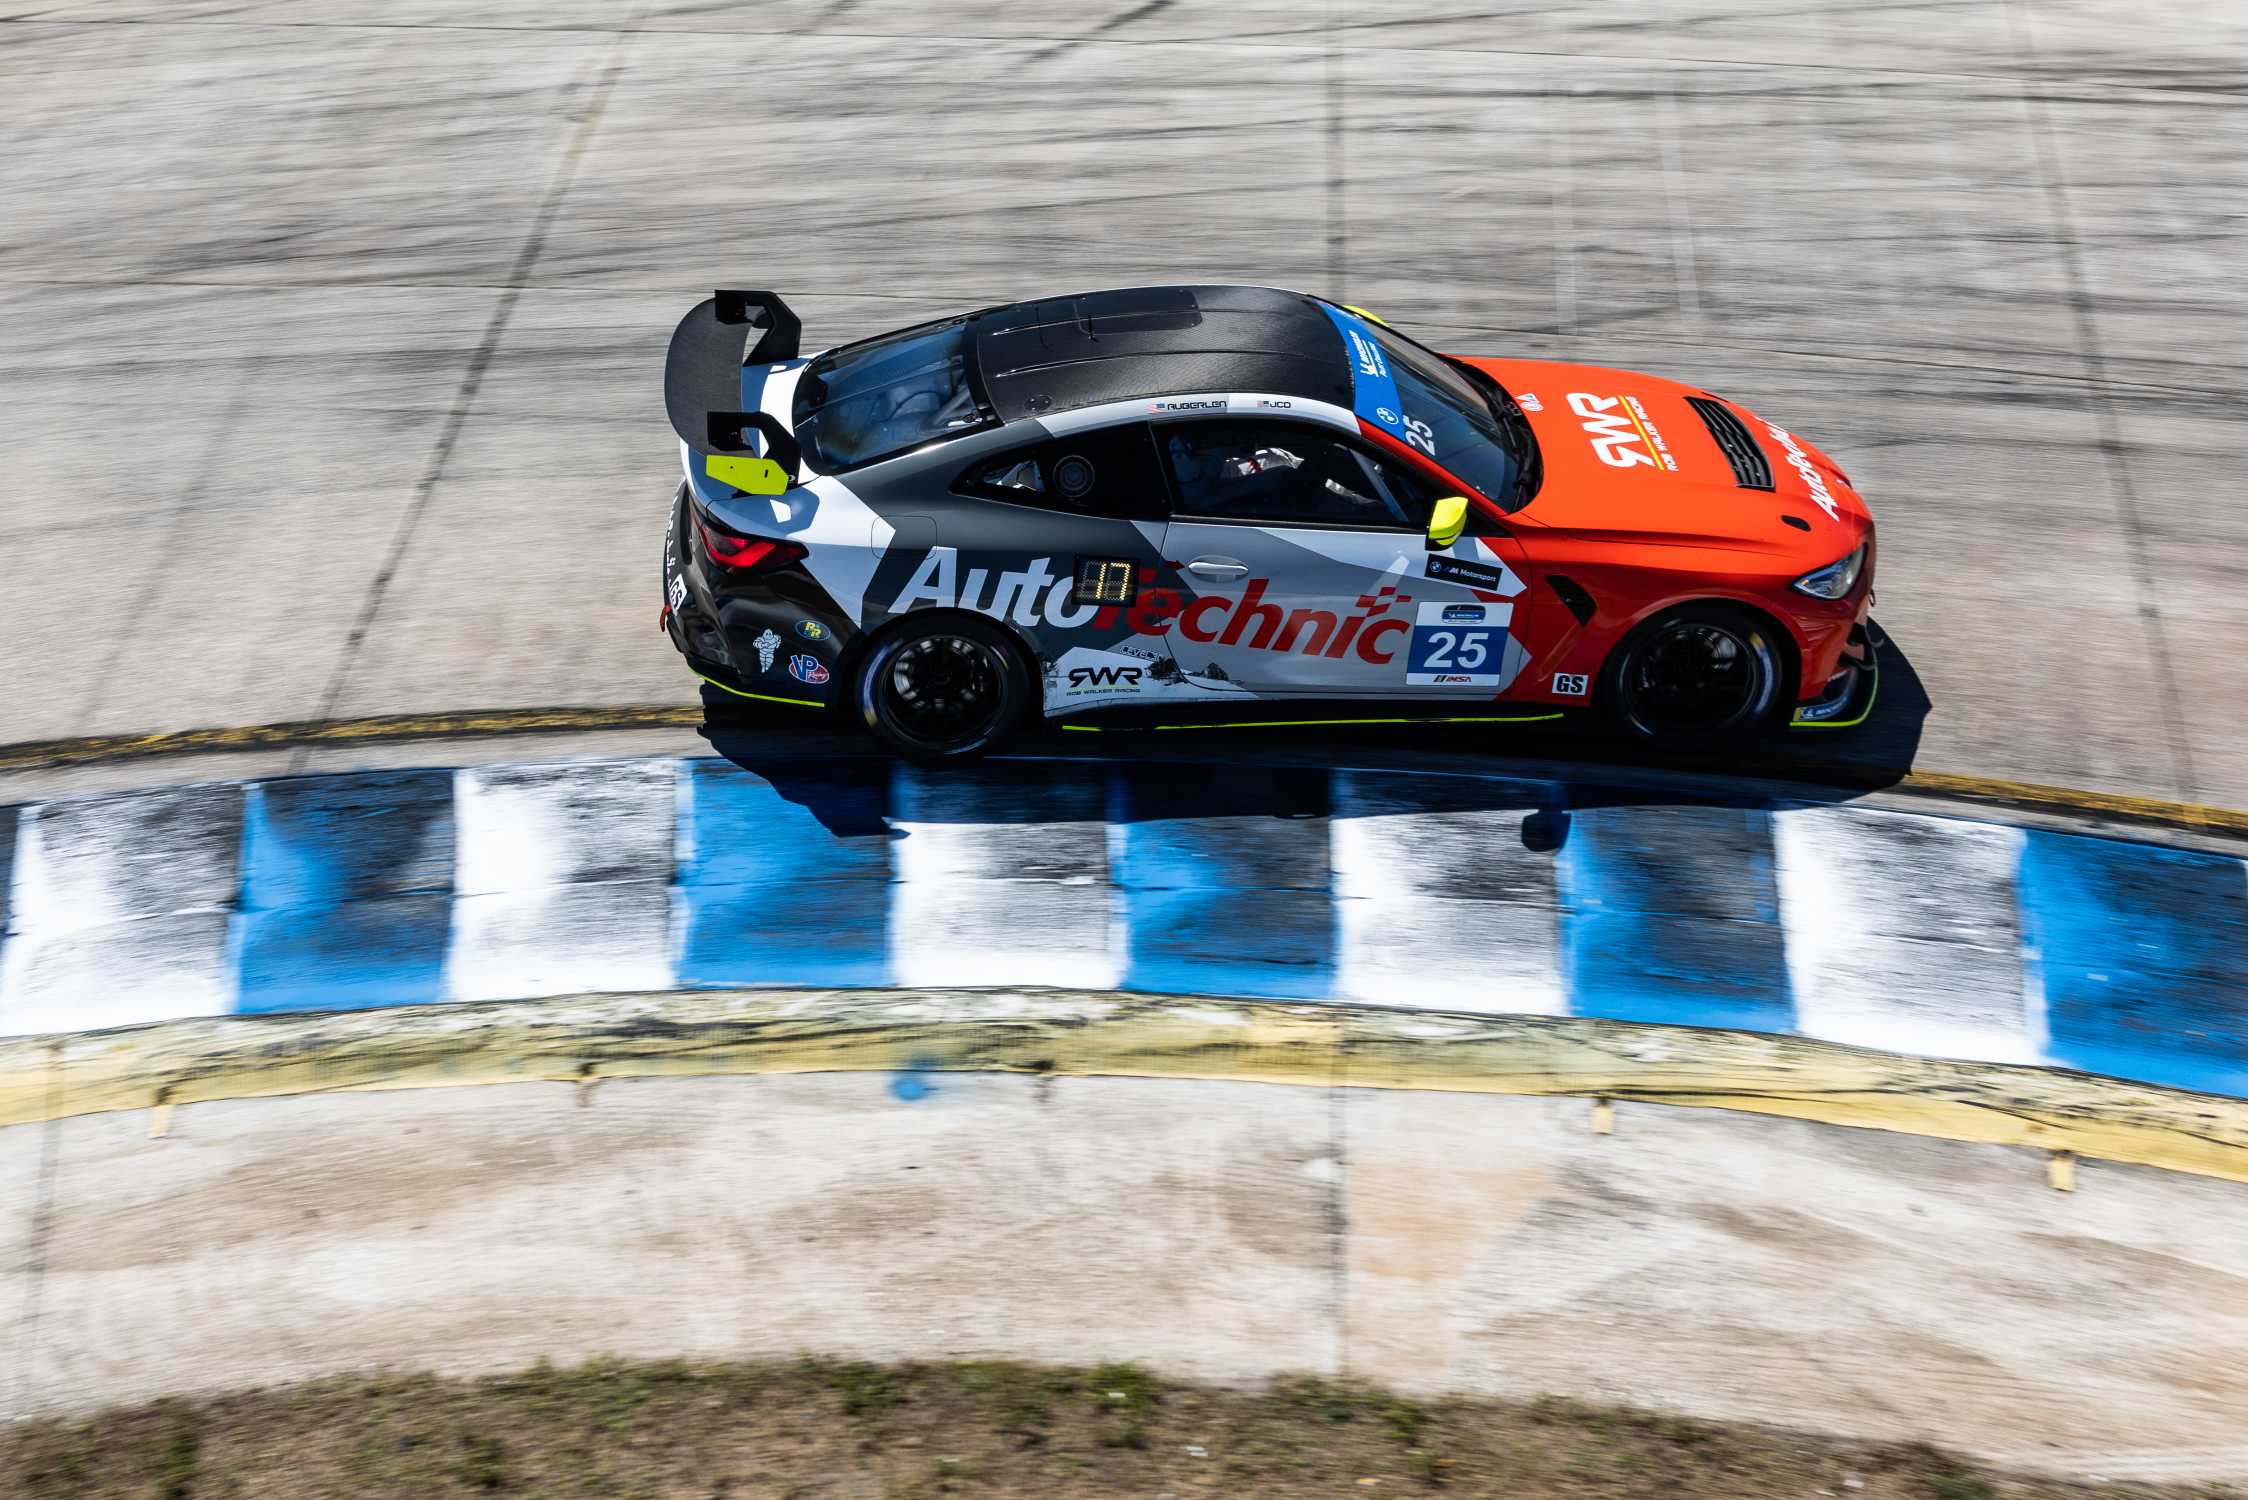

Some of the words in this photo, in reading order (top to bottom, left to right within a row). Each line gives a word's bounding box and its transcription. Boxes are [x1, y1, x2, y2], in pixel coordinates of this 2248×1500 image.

[1167, 400, 1228, 411] AUBERLEN
[1403, 415, 1436, 456] 25
[1096, 562, 1131, 601] 17
[1460, 568, 1497, 582] Motorsport
[1423, 631, 1490, 669] 25
[790, 654, 819, 681] VP
[1556, 674, 1584, 693] GS
